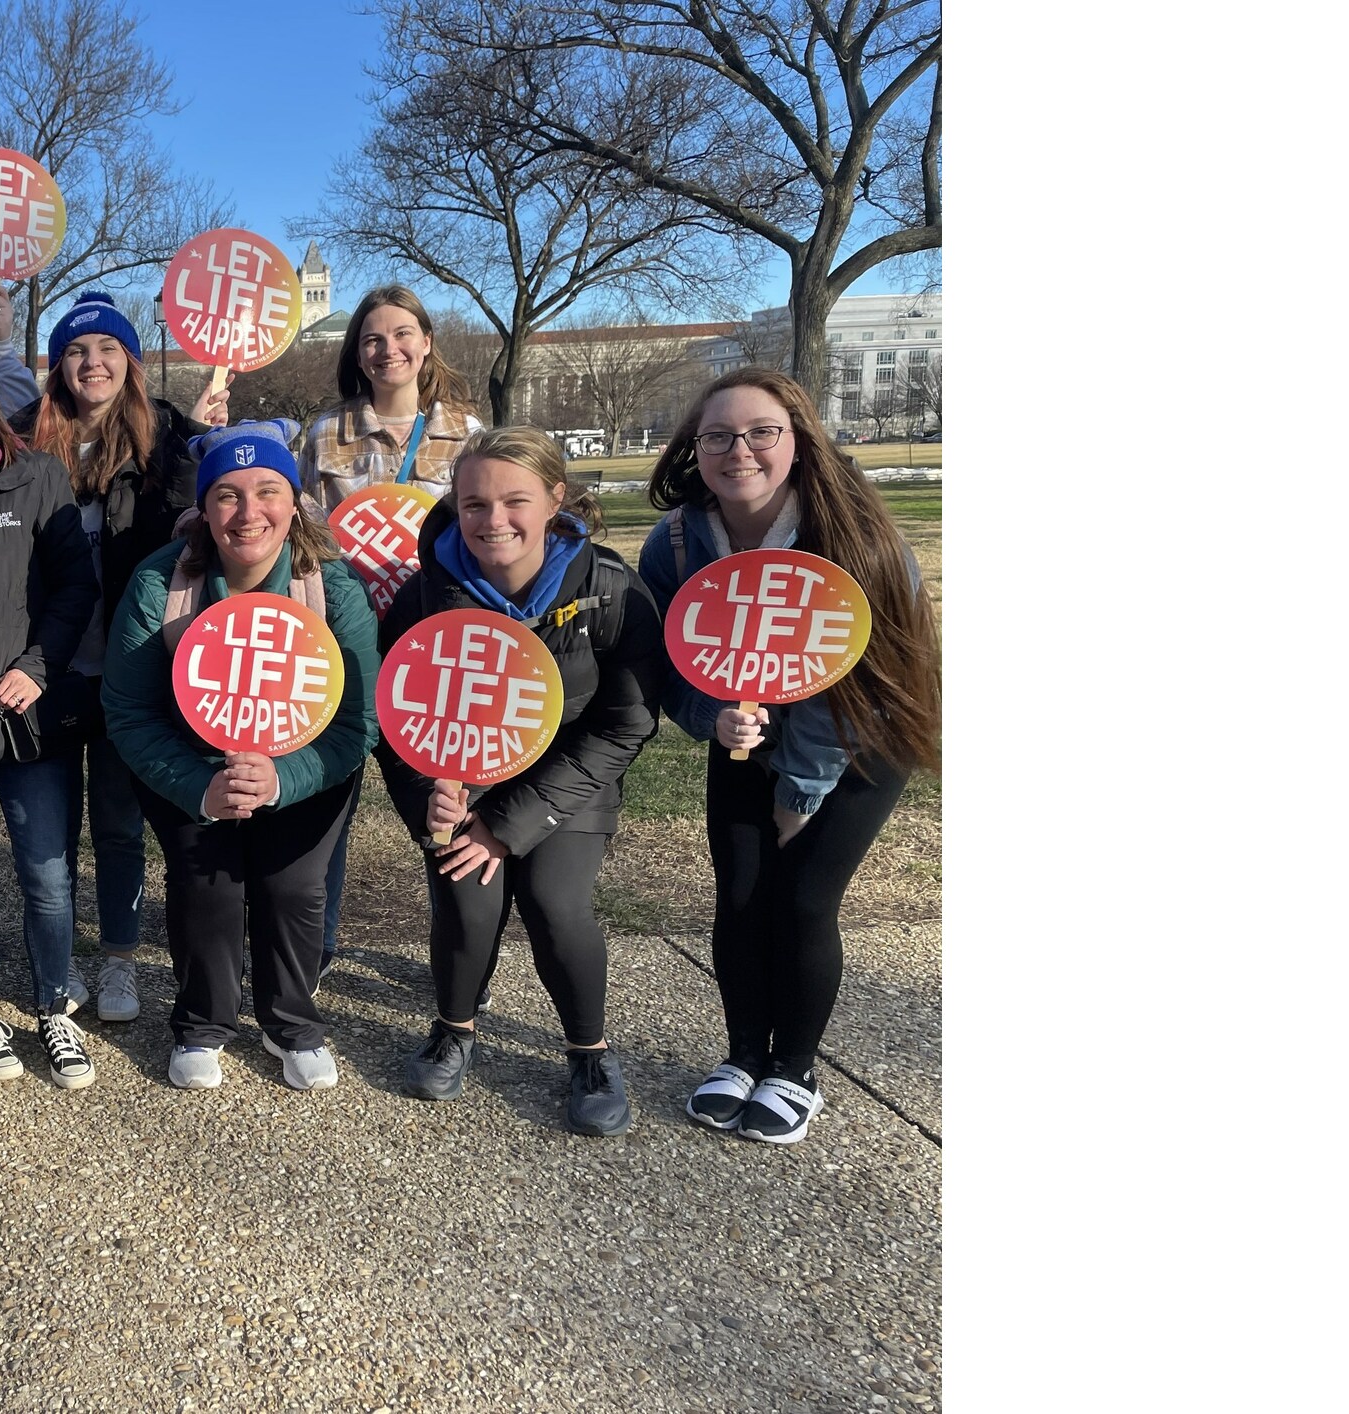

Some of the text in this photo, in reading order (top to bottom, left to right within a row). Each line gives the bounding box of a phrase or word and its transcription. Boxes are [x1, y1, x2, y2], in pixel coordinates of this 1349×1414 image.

[207, 240, 272, 282] LET
[176, 268, 291, 329] LIFE
[181, 312, 275, 360] HAPPEN
[357, 498, 427, 594] IFE
[726, 564, 825, 607] LET
[224, 607, 304, 652] LET
[431, 624, 519, 673] LET
[682, 602, 854, 654] LIFE
[187, 644, 330, 703] LIFE
[692, 648, 827, 694] HAPPEN
[775, 652, 856, 700] SAVETHESTORKS.ORG
[195, 693, 311, 744] HAPPEN
[391, 664, 547, 729] LIFE
[268, 702, 333, 751] SAVETHESTORKS.ORG
[400, 716, 524, 771] HAPPEN
[476, 728, 549, 780] SAVETHESTORKS.ORG
